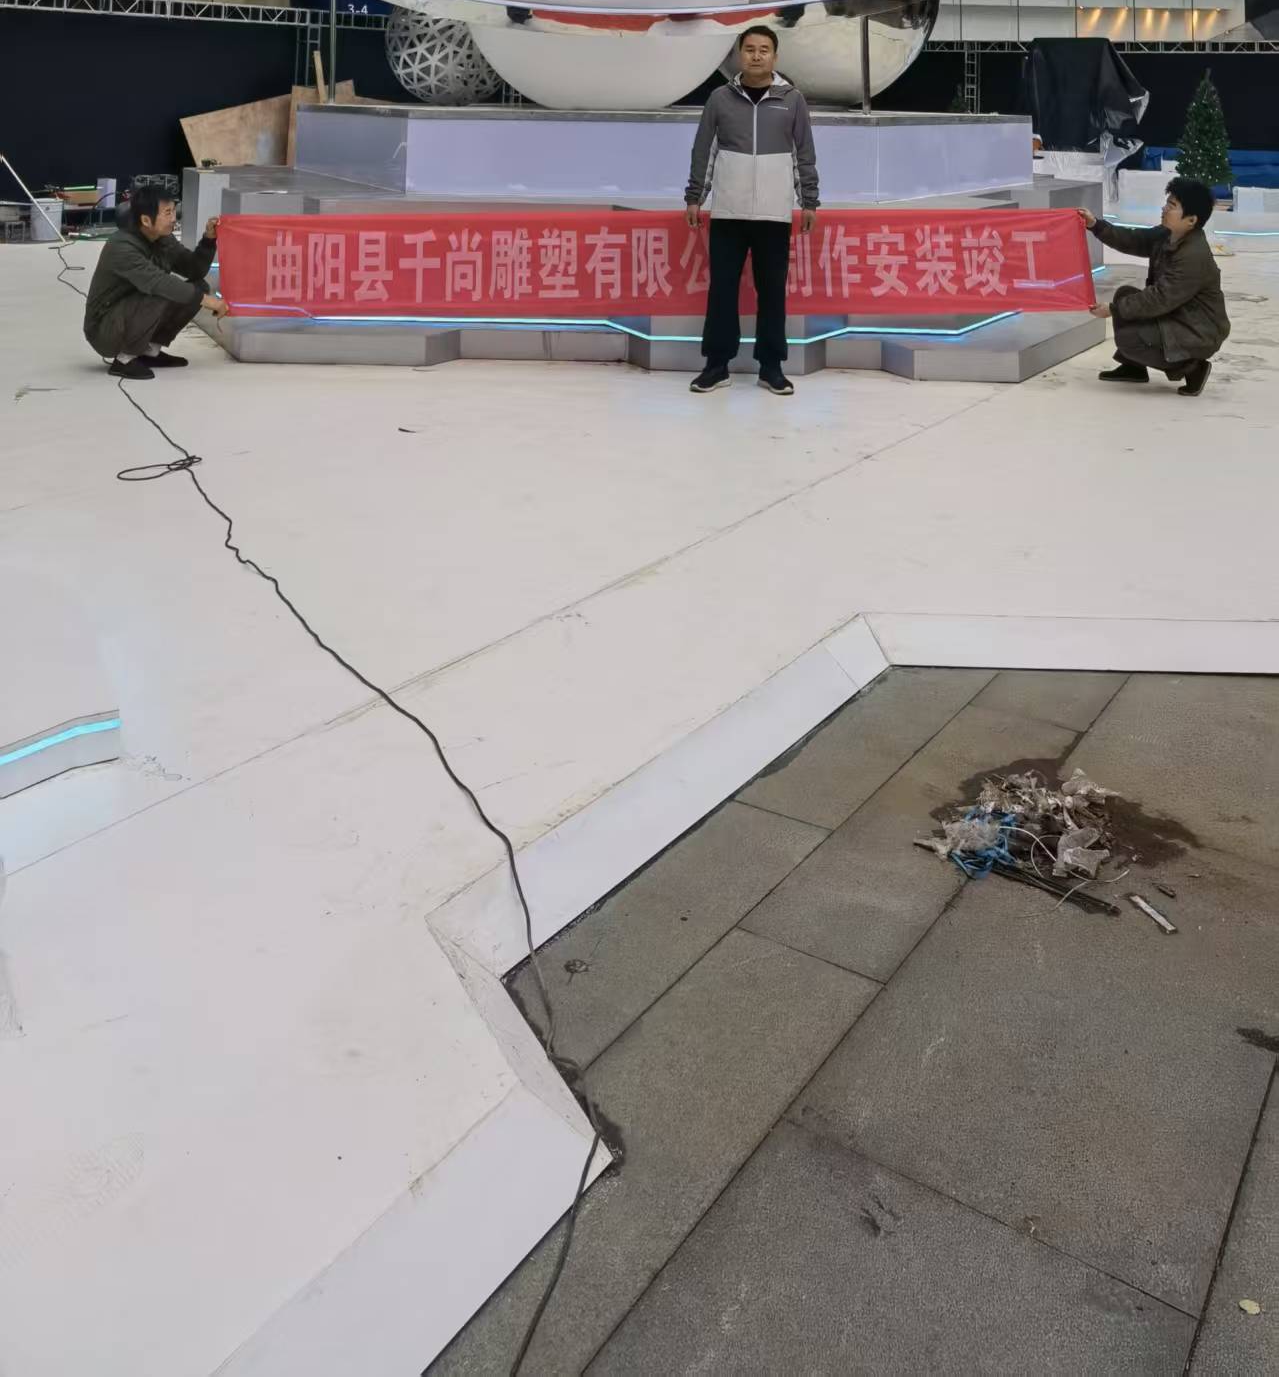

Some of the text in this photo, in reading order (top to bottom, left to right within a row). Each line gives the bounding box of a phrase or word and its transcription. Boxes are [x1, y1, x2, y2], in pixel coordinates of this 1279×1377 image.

[265, 224, 1055, 303] 曲阳县千尚雕塑有限公制作安装竣工
